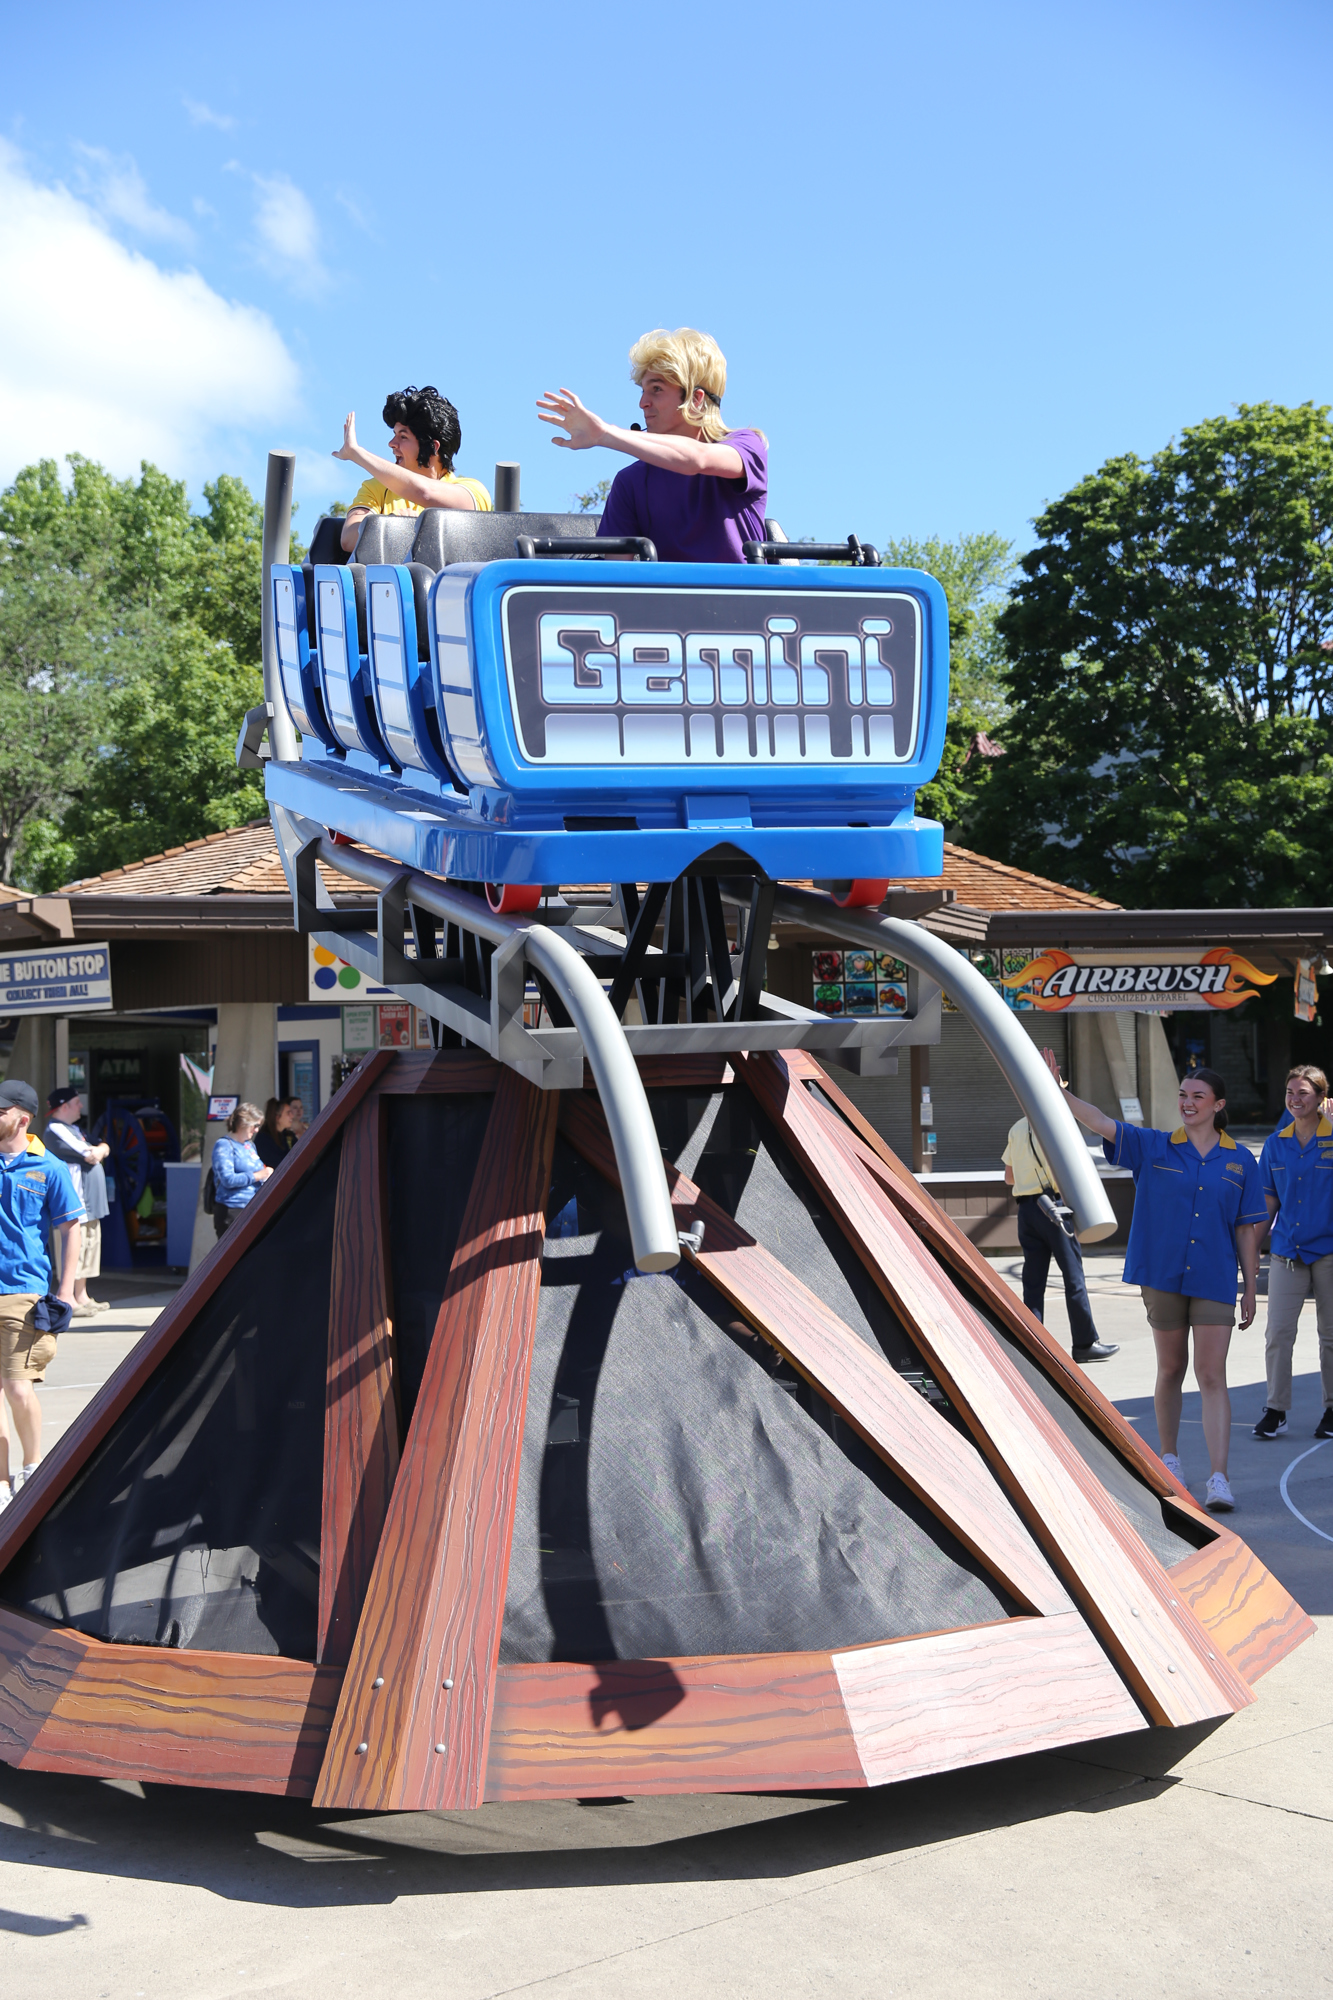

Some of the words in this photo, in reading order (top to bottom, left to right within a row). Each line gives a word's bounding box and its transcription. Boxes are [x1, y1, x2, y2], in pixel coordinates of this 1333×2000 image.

[539, 612, 895, 706] Gemini
[14, 958, 68, 981] BUTTON
[69, 954, 104, 976] STOP
[6, 987, 41, 1001] COLLECT
[42, 985, 67, 999] THEM
[69, 983, 88, 997] ALL!
[1042, 964, 1231, 998] AIRBRUSH
[1087, 994, 1149, 1003] CUSTOMIZED
[1150, 993, 1189, 1002] APPAREL
[100, 1058, 140, 1074] ATM
